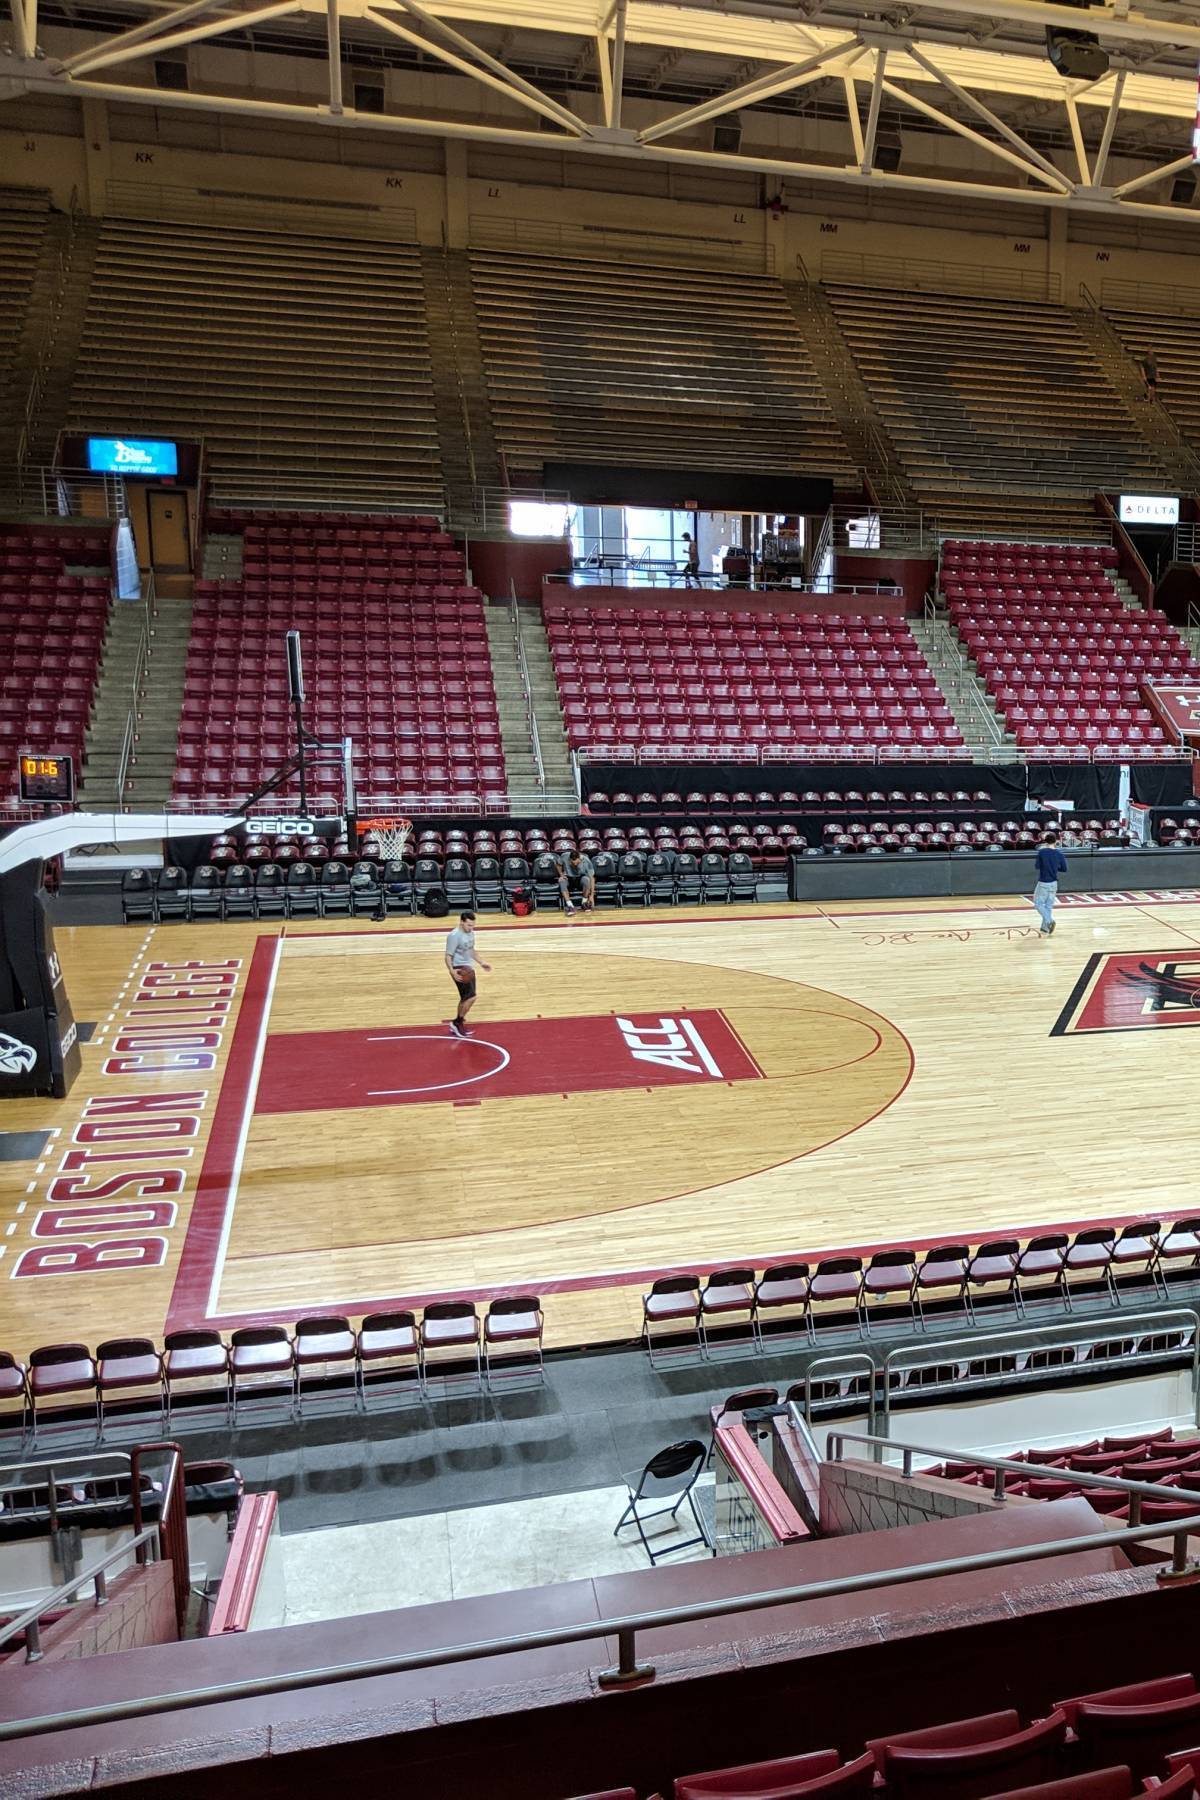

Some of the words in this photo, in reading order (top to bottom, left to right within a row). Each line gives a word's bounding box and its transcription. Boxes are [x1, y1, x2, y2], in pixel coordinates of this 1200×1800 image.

[135, 152, 153, 164] KK
[385, 177, 403, 189] KK
[488, 188, 501, 199] LL
[734, 213, 746, 224] LL
[820, 223, 838, 233] MM
[1013, 243, 1031, 253] MM
[1096, 252, 1110, 262] NN
[1137, 505, 1176, 515] DELTA
[246, 820, 314, 834] GEICO
[102, 958, 242, 1075] COLLEGE
[616, 1017, 703, 1074] ACC
[10, 1090, 208, 1280] BOSTON
